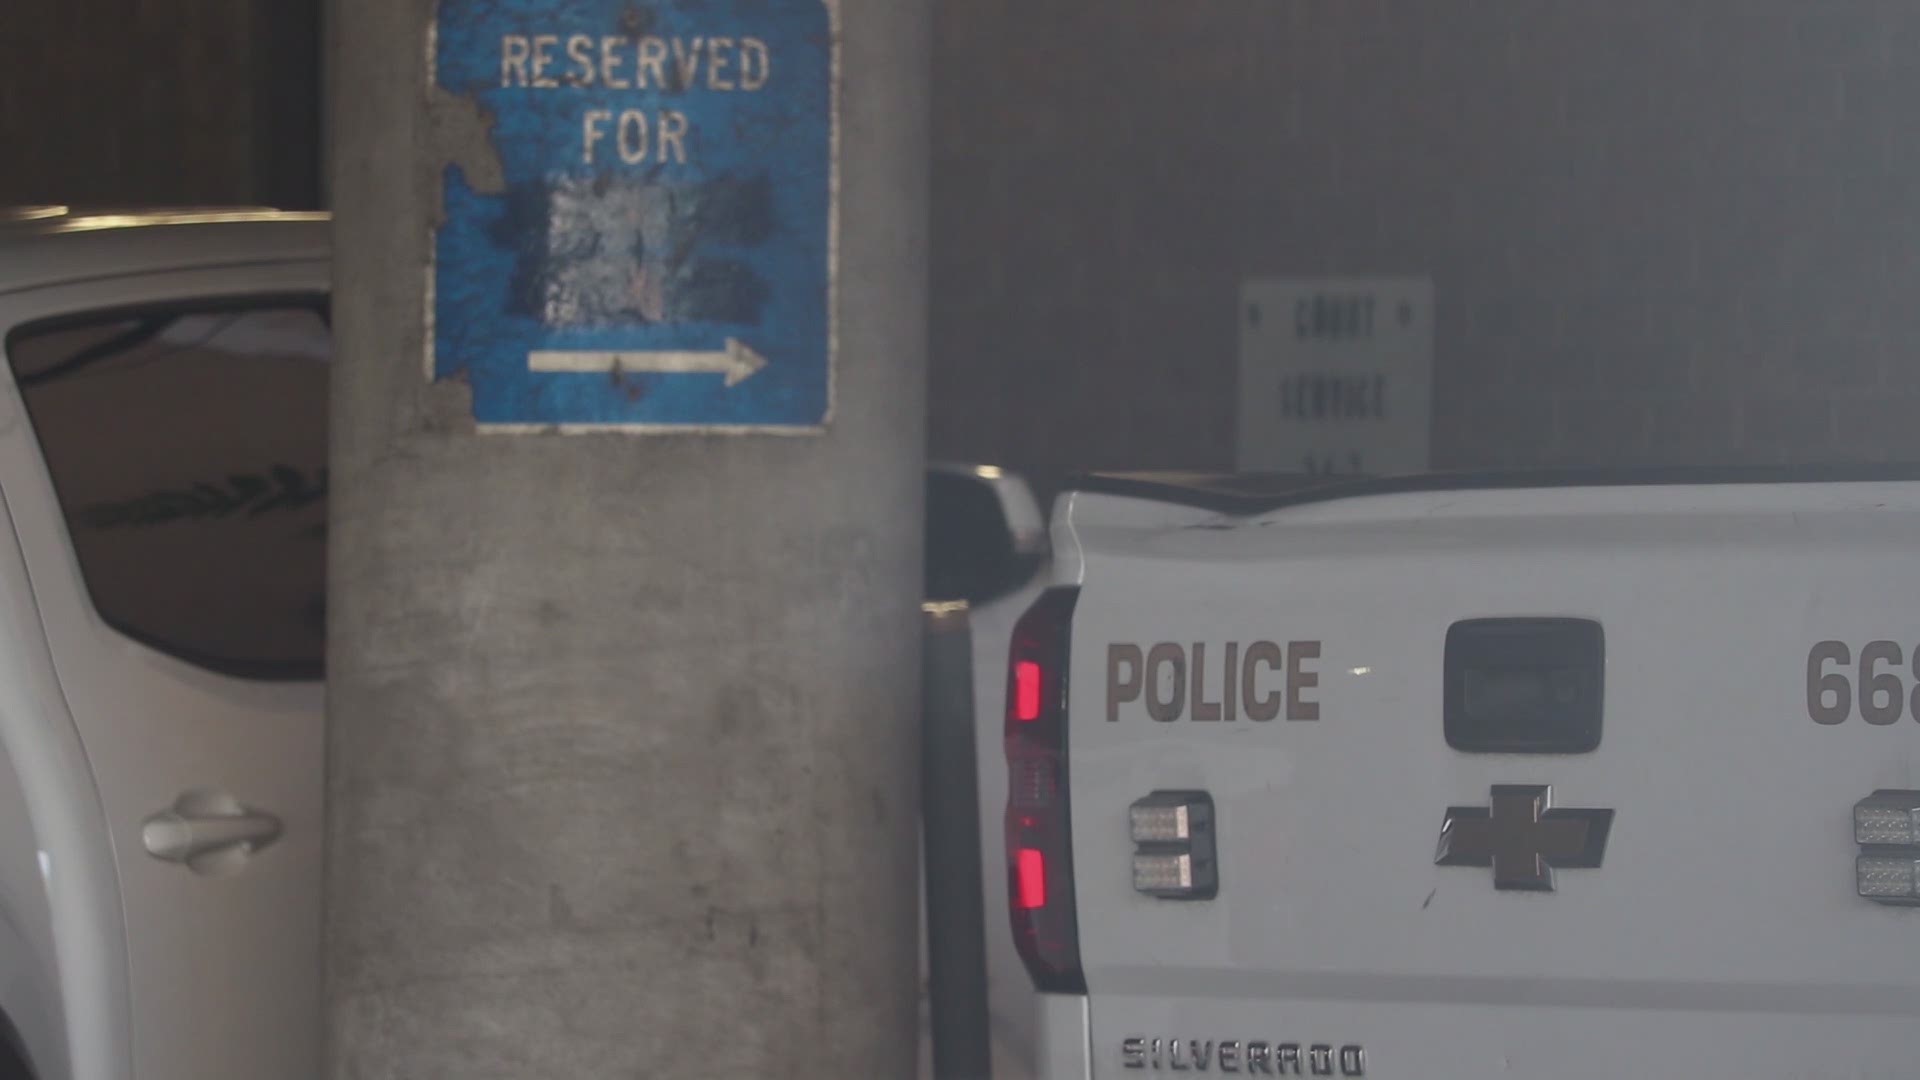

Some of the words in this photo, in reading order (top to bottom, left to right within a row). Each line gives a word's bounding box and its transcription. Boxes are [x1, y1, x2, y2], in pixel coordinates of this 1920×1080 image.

[501, 34, 770, 91] RESERVED
[582, 110, 689, 165] FOR
[1106, 641, 1321, 722] POLICE
[1807, 640, 1920, 726] 66
[1122, 1038, 1365, 1076] SILVERADO
